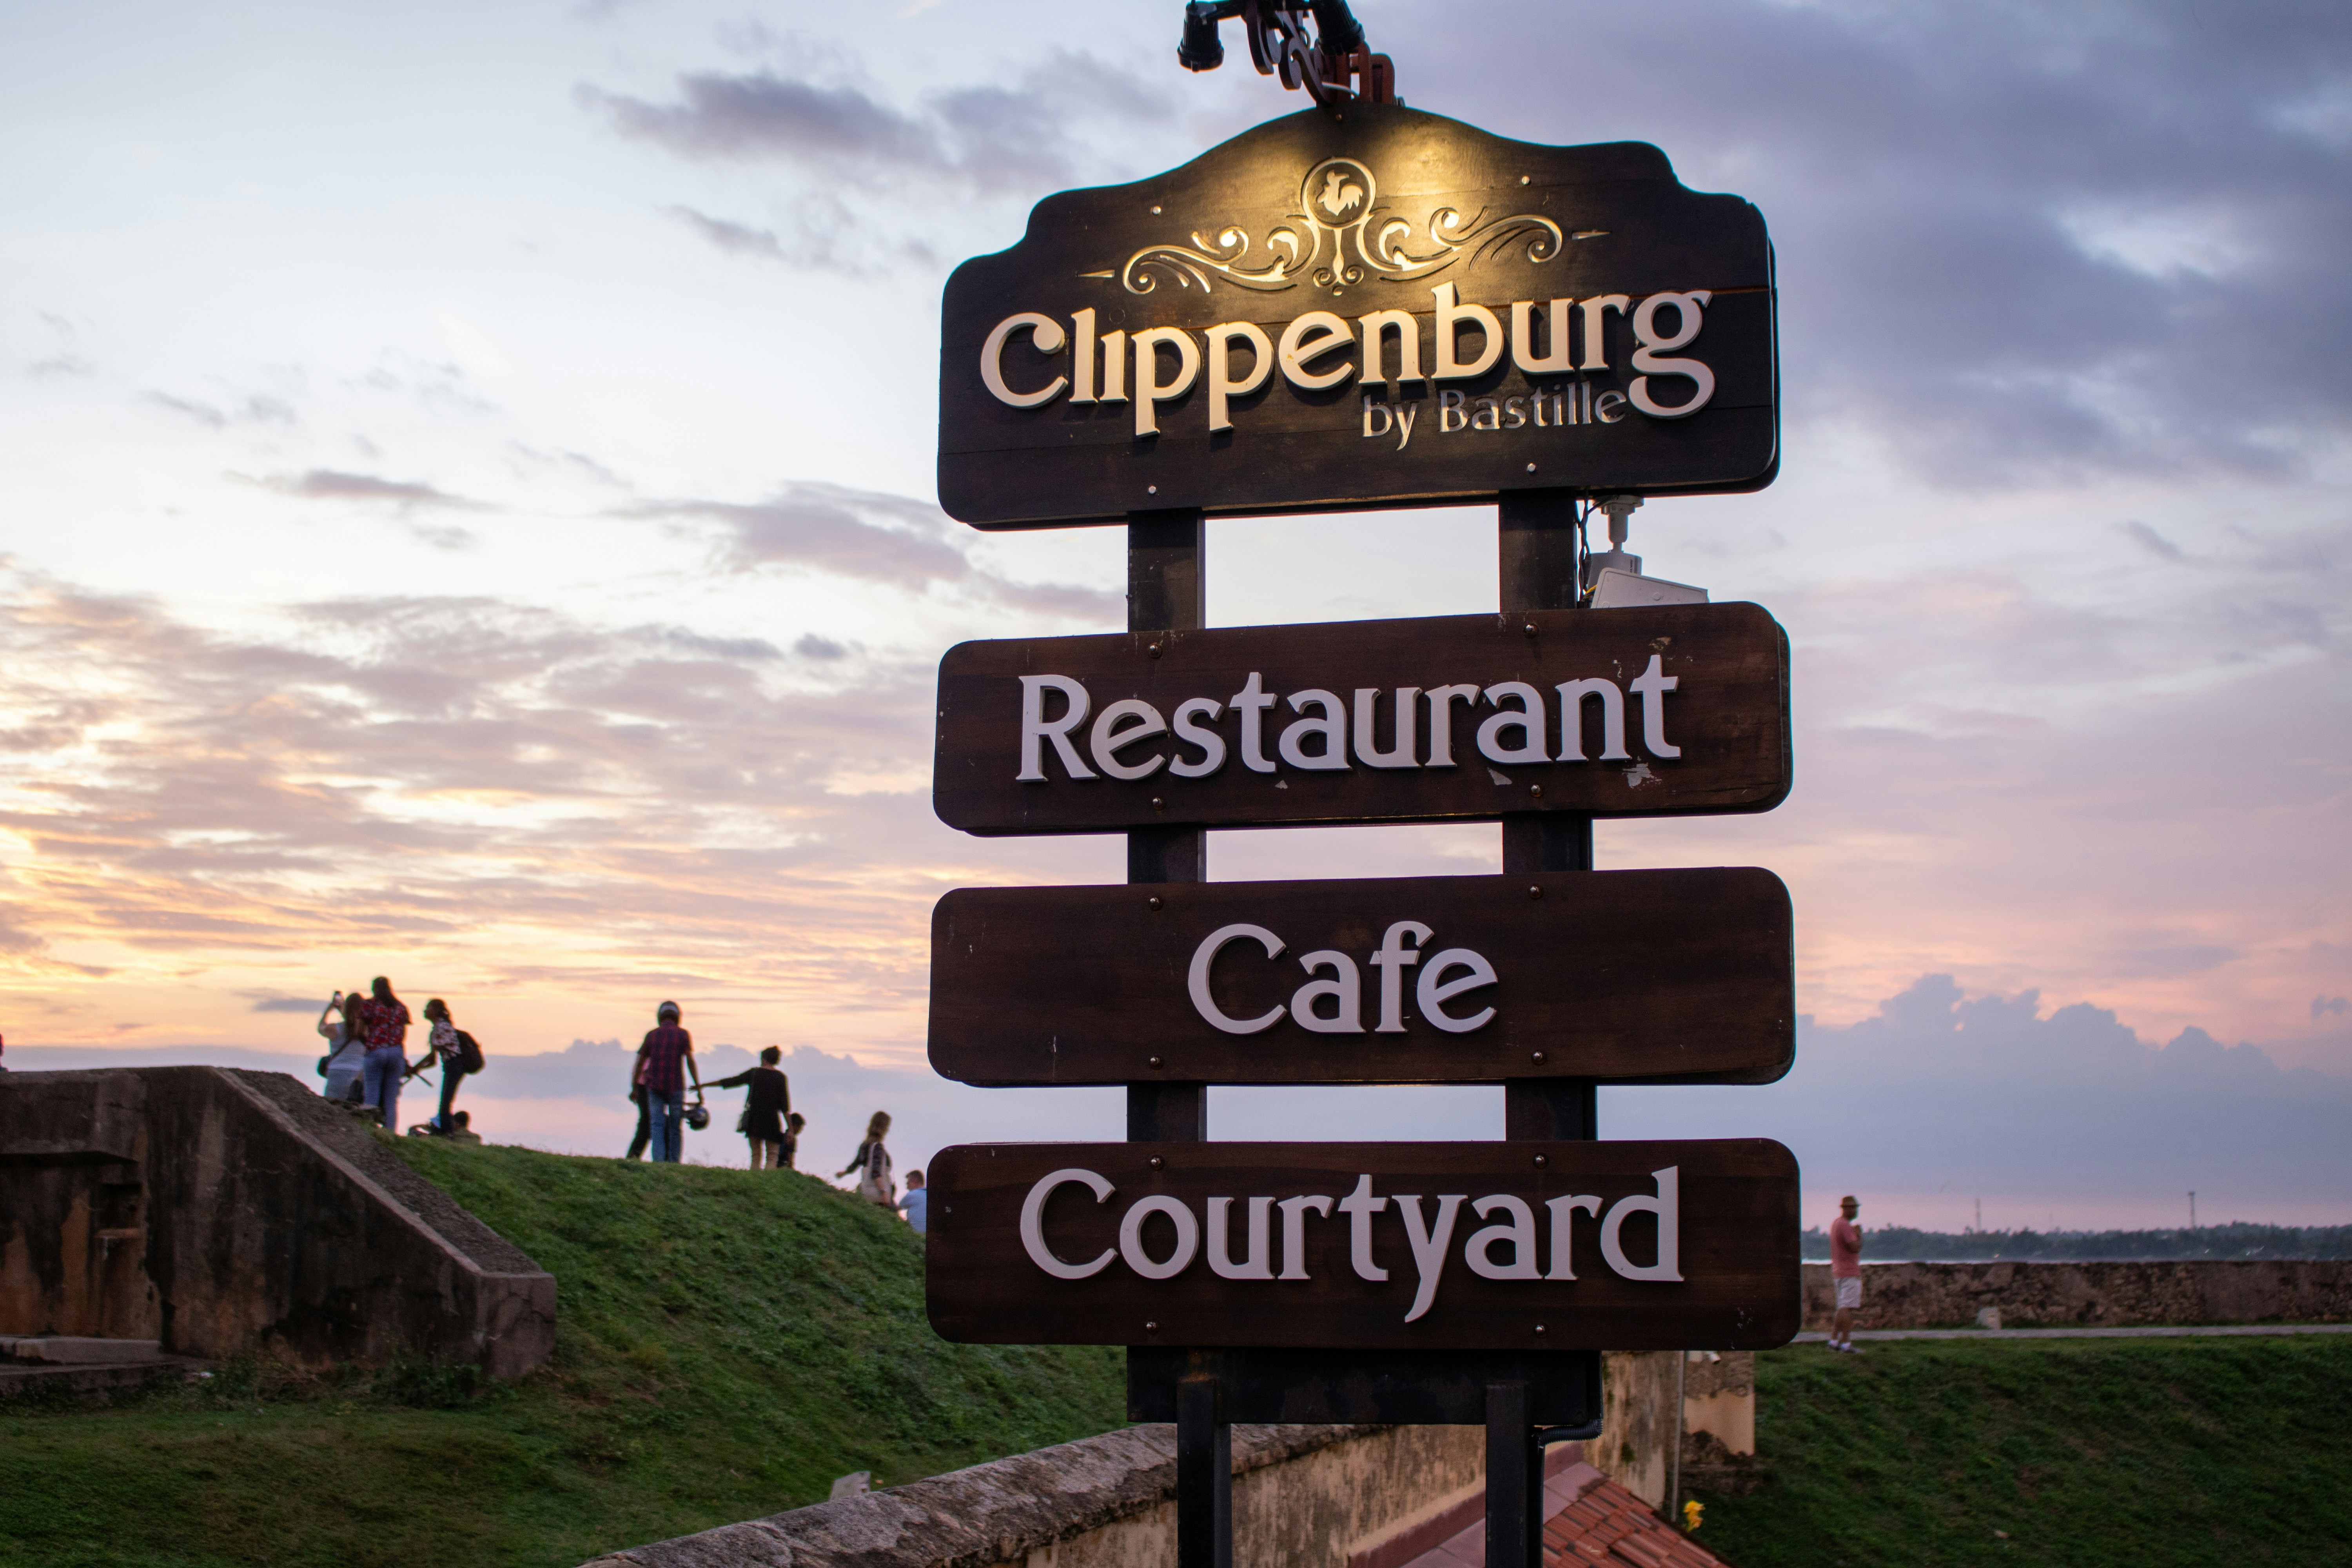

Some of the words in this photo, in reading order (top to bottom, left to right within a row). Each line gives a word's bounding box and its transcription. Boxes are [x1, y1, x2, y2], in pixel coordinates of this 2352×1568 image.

[980, 281, 1715, 437] Clippenburg
[1363, 395, 1416, 450] by
[1440, 381, 1627, 433] Bastille
[1016, 655, 1681, 782] Restaurant
[1188, 921, 1498, 1034] Cafe
[1020, 1166, 1684, 1323] Courtyard
